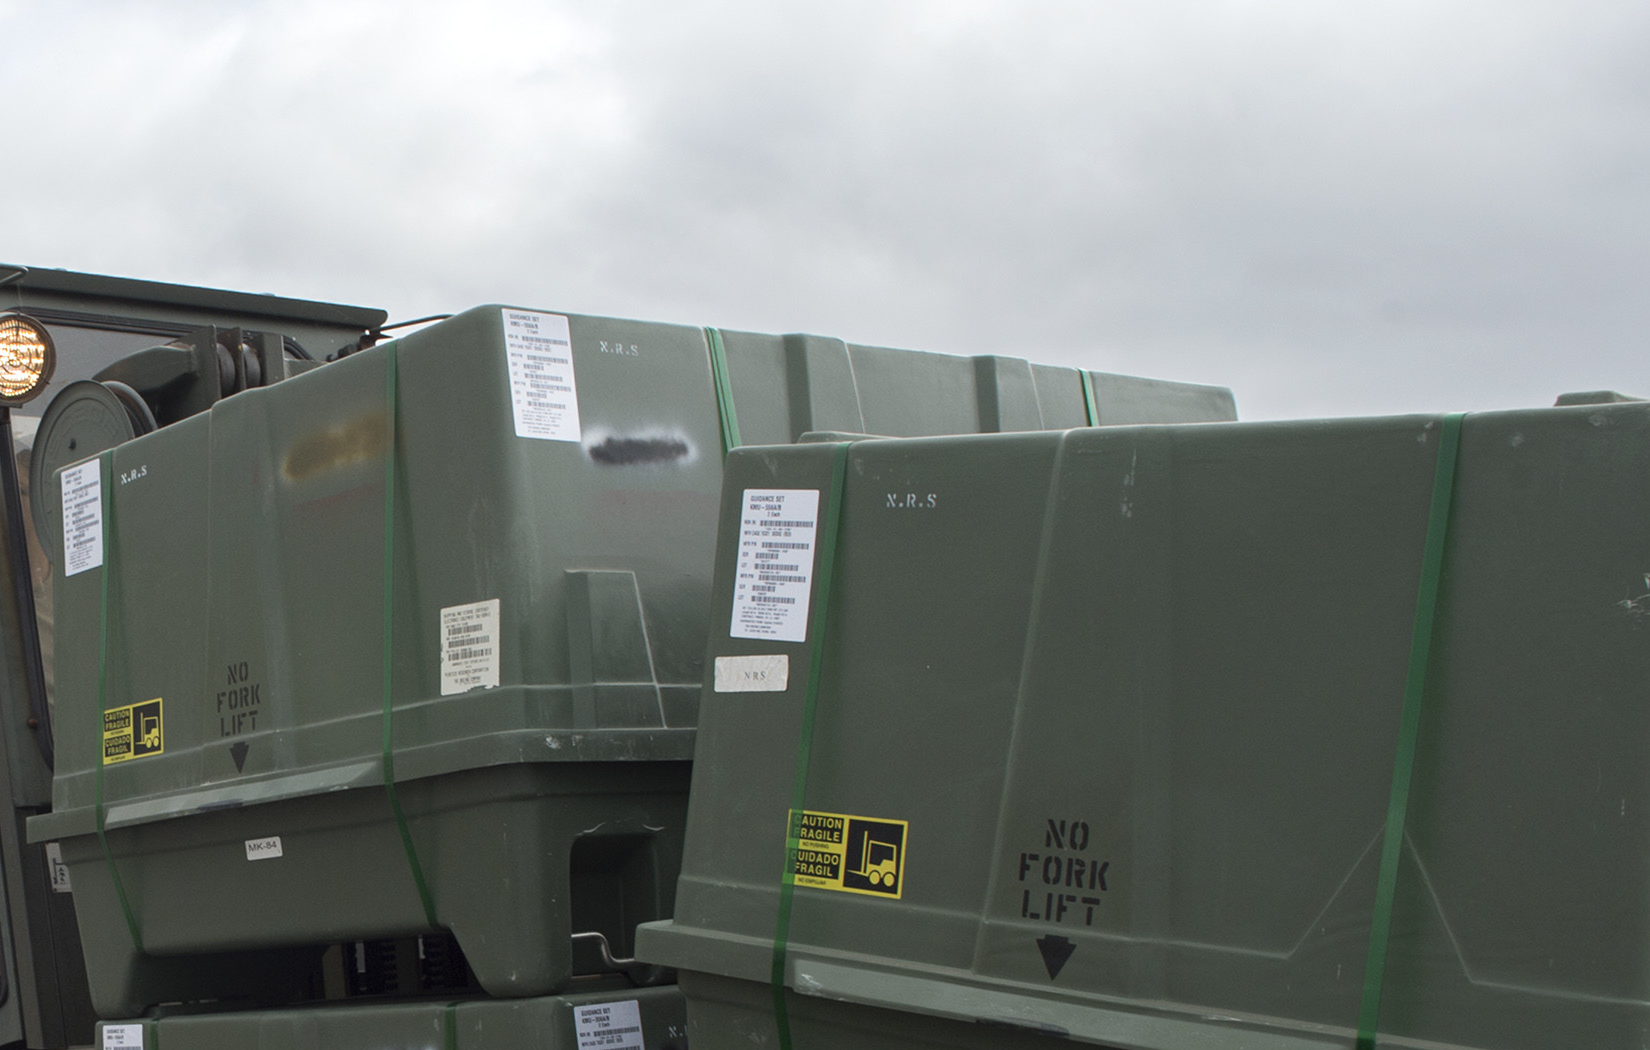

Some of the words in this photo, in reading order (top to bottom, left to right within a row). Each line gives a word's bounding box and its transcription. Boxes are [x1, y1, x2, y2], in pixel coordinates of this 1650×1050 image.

[121, 465, 147, 485] N.R.S
[886, 493, 937, 508] N.R.S
[227, 662, 248, 685] NO
[217, 684, 260, 713] FORK
[104, 709, 130, 721] CAUTION
[221, 710, 258, 737] LIFT
[105, 719, 130, 731] FRAGILE
[105, 735, 130, 747] CUIDADO
[107, 744, 128, 755] FRAGIL
[1045, 818, 1089, 851] NO
[248, 841, 277, 851] MK-84
[1019, 852, 1110, 891] FORK
[1021, 889, 1101, 926] LIFT
[668, 1025, 687, 1038] N.
